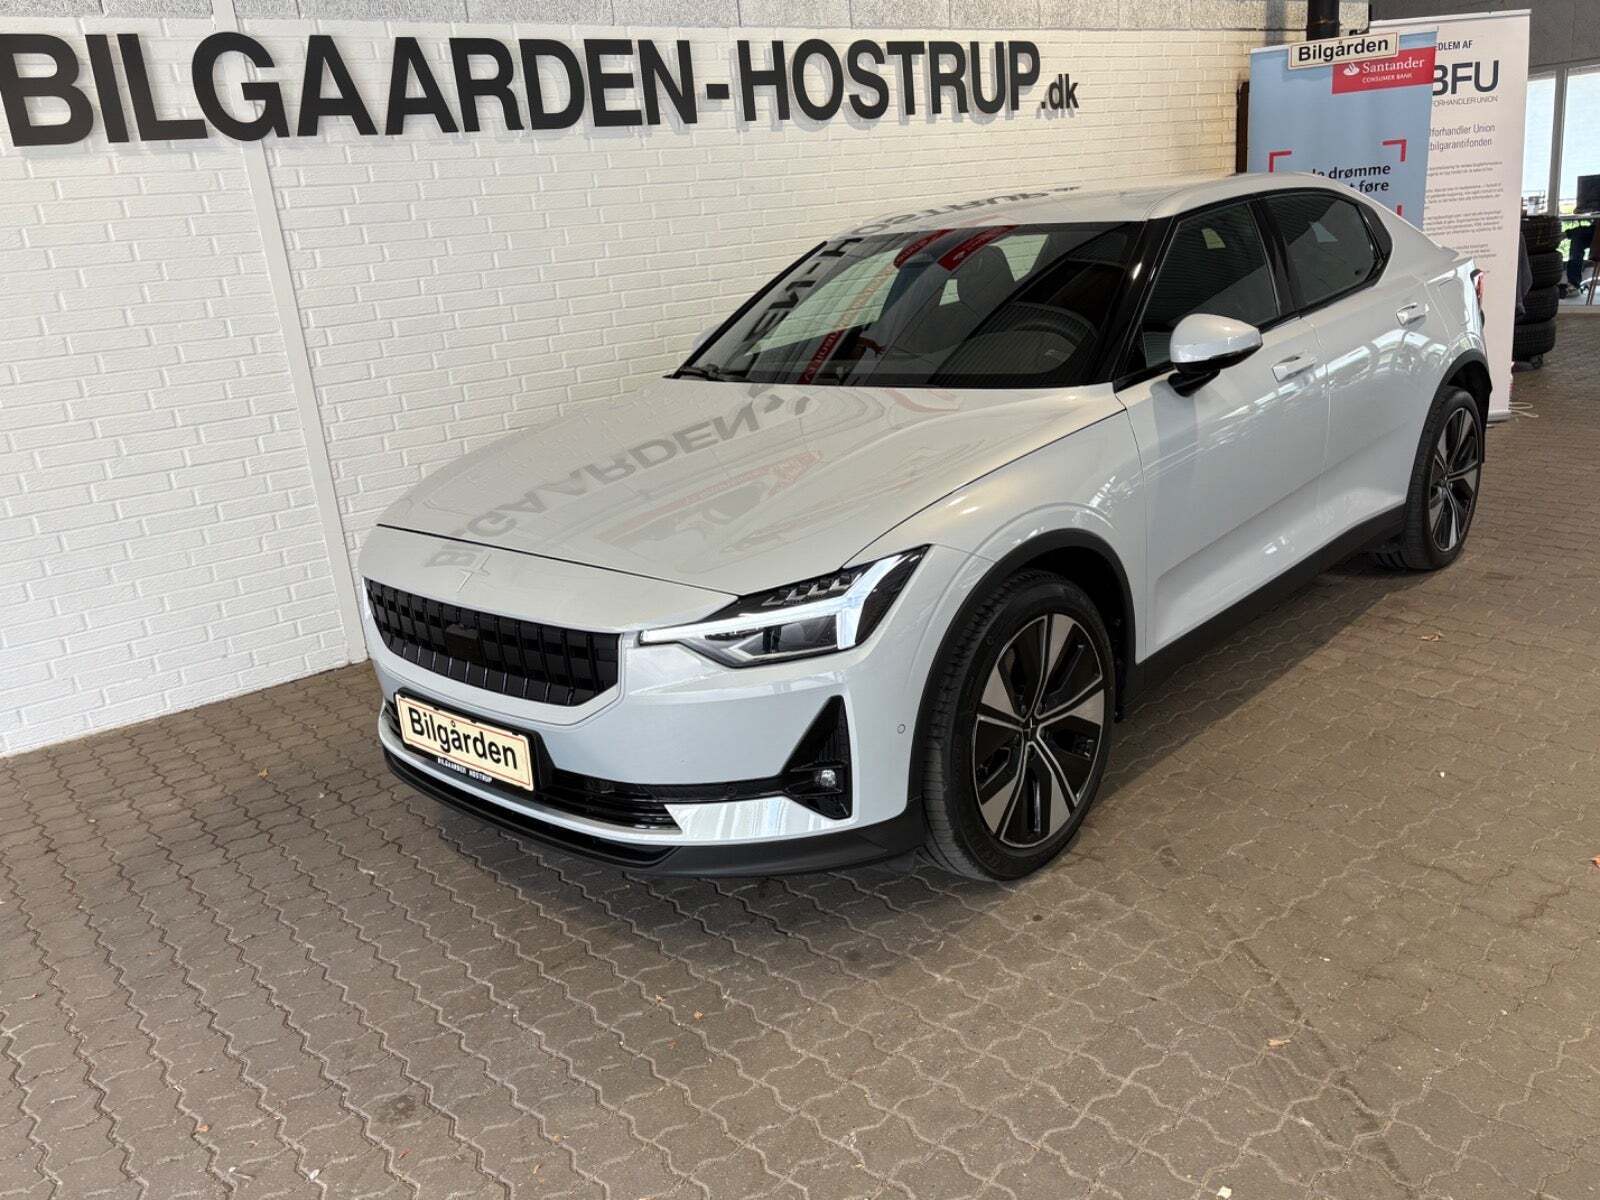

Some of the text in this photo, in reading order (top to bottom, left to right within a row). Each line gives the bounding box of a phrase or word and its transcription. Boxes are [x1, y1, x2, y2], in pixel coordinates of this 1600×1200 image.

[1298, 39, 1389, 62] Bilgården
[1435, 40, 1474, 51] DLEM AF
[1362, 57, 1425, 74] Santander
[1361, 73, 1413, 84] CONSUMER BANK
[1473, 123, 1495, 133] Union
[1328, 165, 1391, 179] drømme
[1359, 180, 1389, 193] føre
[408, 706, 518, 770] Bilgården
